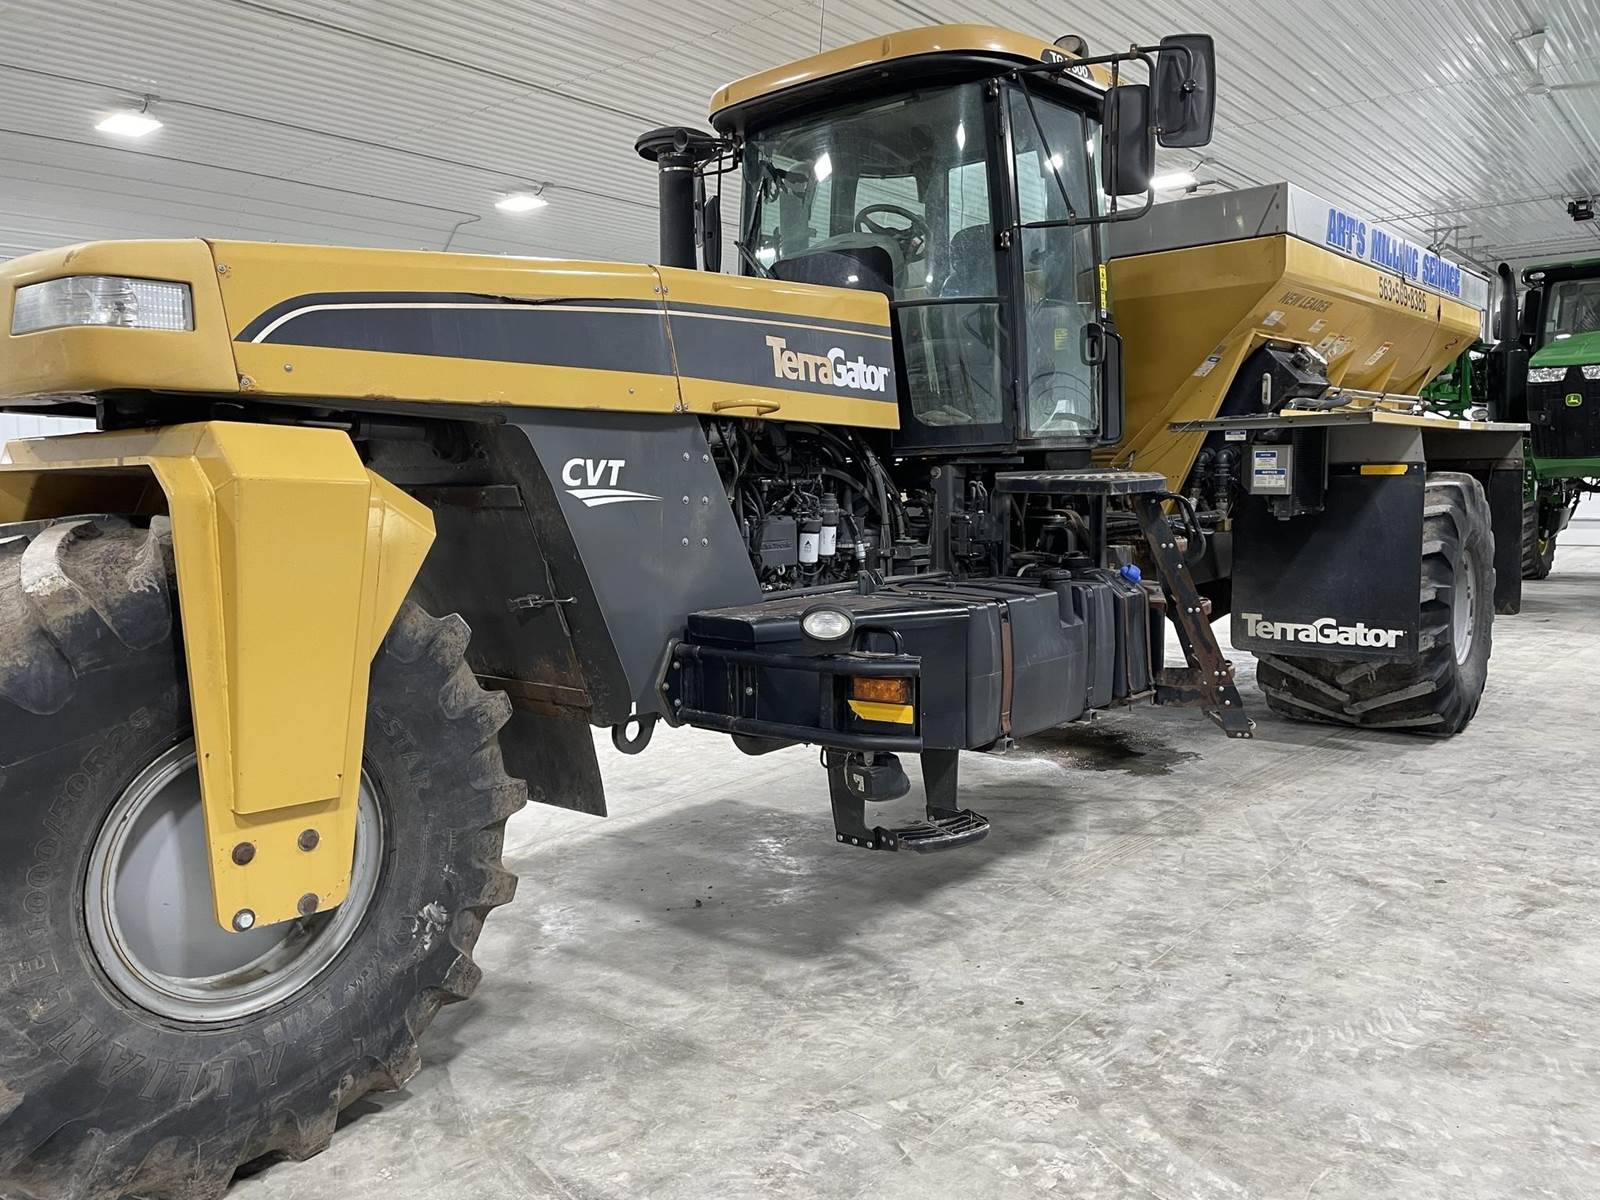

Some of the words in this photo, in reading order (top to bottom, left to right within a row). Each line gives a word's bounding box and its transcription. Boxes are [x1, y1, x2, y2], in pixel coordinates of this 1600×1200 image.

[1326, 208, 1366, 258] ART'S
[1371, 229, 1418, 280] MILLING
[1422, 254, 1460, 298] SERVICE
[766, 335, 889, 392] TerraGator
[561, 457, 626, 486] CVT
[1241, 612, 1404, 648] TerraGator
